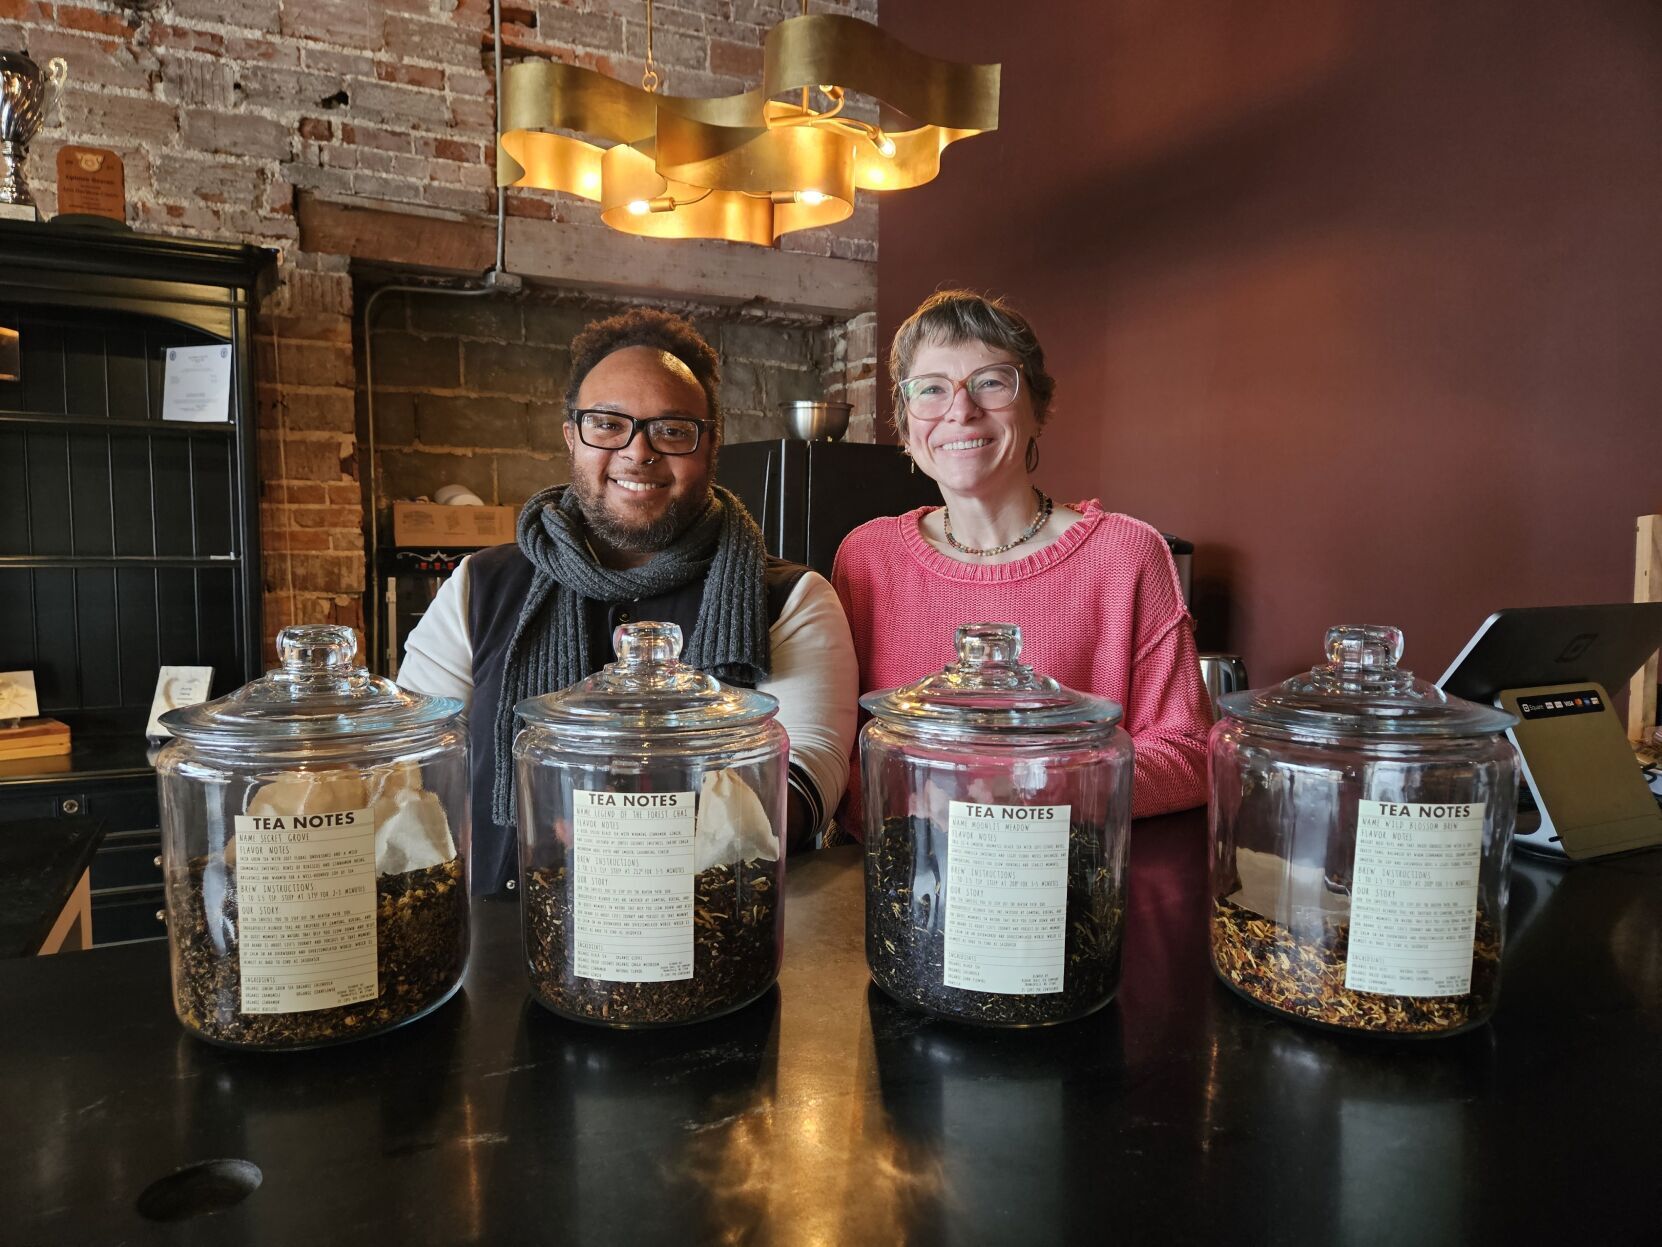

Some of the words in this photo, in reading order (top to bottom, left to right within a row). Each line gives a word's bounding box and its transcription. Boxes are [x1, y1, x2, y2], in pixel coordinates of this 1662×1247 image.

[589, 794, 616, 805] TEA
[623, 795, 677, 807] NOTES
[594, 809, 616, 818] LEGEND
[620, 810, 627, 819] OF
[633, 810, 642, 819] THE
[647, 810, 668, 819] FOREST
[673, 809, 688, 818] CHAI
[966, 805, 994, 818] TEA
[1002, 808, 1054, 820] NOTES
[1380, 803, 1411, 817] TEA
[1419, 805, 1470, 818] NOTES
[253, 818, 285, 830] TEA
[293, 812, 355, 829] NOTES
[577, 819, 597, 829] FLAVOR
[601, 821, 619, 830] NOTES
[952, 819, 967, 828] NAME
[972, 821, 1000, 831] MOONLIT
[1005, 823, 1030, 832] MEADOW
[1362, 817, 1380, 827] NAME
[1385, 820, 1403, 829] WILD
[1409, 822, 1439, 831] BLOSSOM
[1443, 822, 1459, 830] BREW
[240, 834, 256, 842] NAME
[260, 833, 282, 843] SECRET
[288, 832, 309, 842] GROVE
[952, 829, 973, 839] FLAVOR
[978, 832, 997, 842] NOTES
[1361, 829, 1387, 839] FLAVOR
[1392, 831, 1412, 842] NOTES
[240, 845, 263, 855] FLAVOR
[269, 845, 290, 855] NOTES
[577, 855, 590, 863] BREW
[595, 856, 640, 867] INSTRUCTIONS
[971, 868, 1016, 880] INSTRUCTIONS
[1358, 866, 1375, 875] BREW
[1382, 868, 1431, 880] INSTRUCTIONS
[241, 884, 257, 893] BREW
[263, 882, 315, 893] INSTRUCTIONS
[592, 877, 608, 887] STORY
[966, 888, 984, 897] STORY
[1357, 886, 1369, 895] OUR
[1375, 888, 1396, 898] STORY
[242, 906, 253, 914] OUR
[260, 905, 278, 915] STORY
